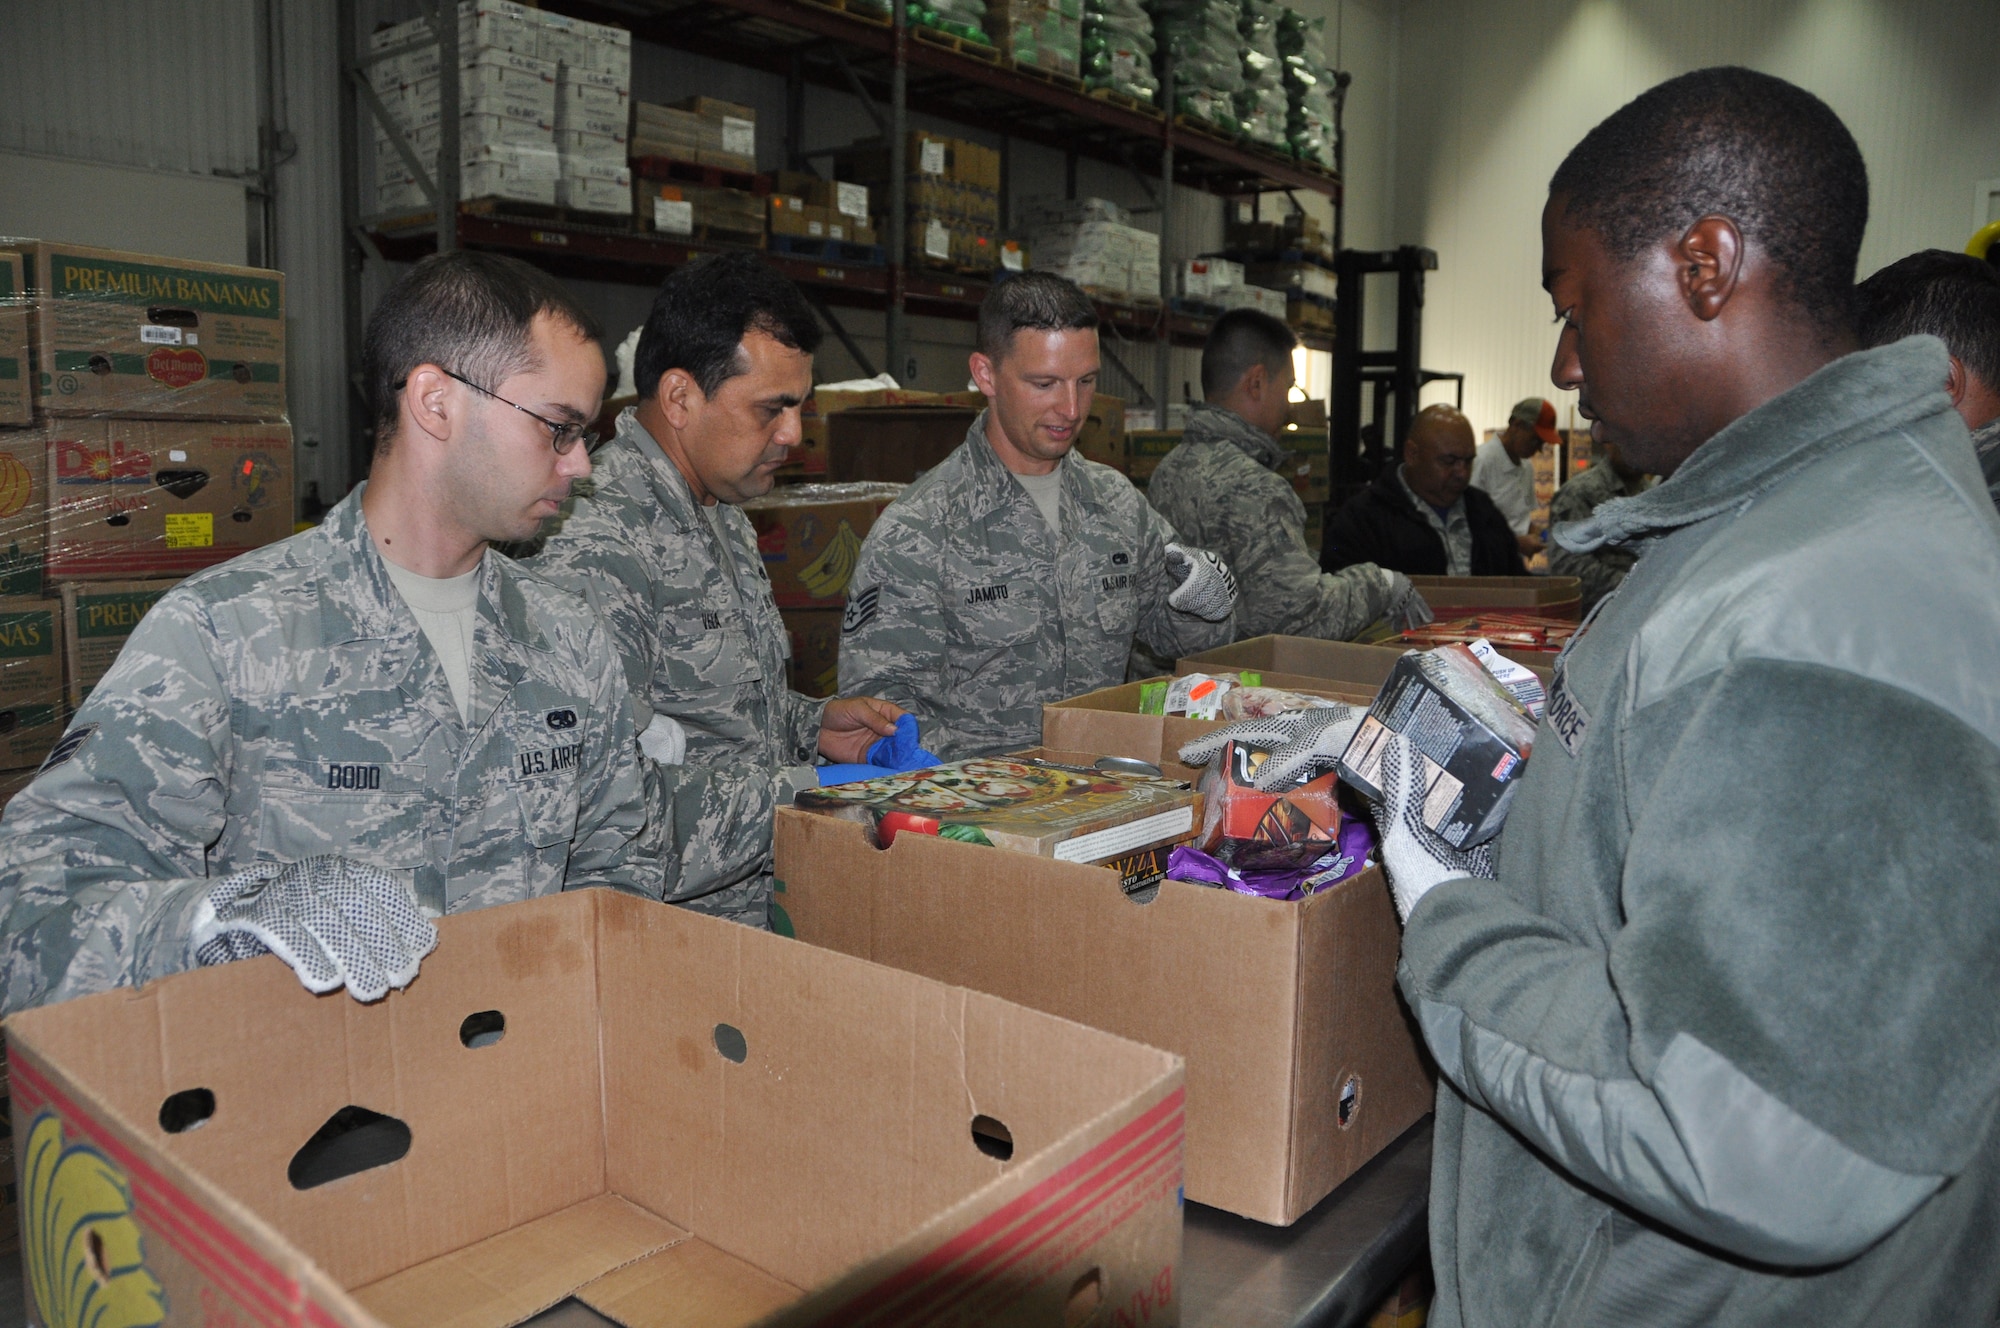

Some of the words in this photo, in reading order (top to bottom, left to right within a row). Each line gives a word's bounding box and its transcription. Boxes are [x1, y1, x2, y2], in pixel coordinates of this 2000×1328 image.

[64, 265, 172, 299] PREMIUM
[176, 278, 271, 309] BANANAS
[152, 357, 170, 371] Del
[171, 358, 204, 372] Monte
[907, 358, 917, 379] 6
[56, 440, 153, 480] Dole
[60, 495, 148, 511] BAANAS
[967, 584, 1009, 604] JAMITO
[89, 602, 151, 627] PREM
[1359, 724, 1372, 740] Facts
[520, 750, 548, 775] U.S.
[328, 764, 380, 790] DODD
[1121, 875, 1138, 888] STO
